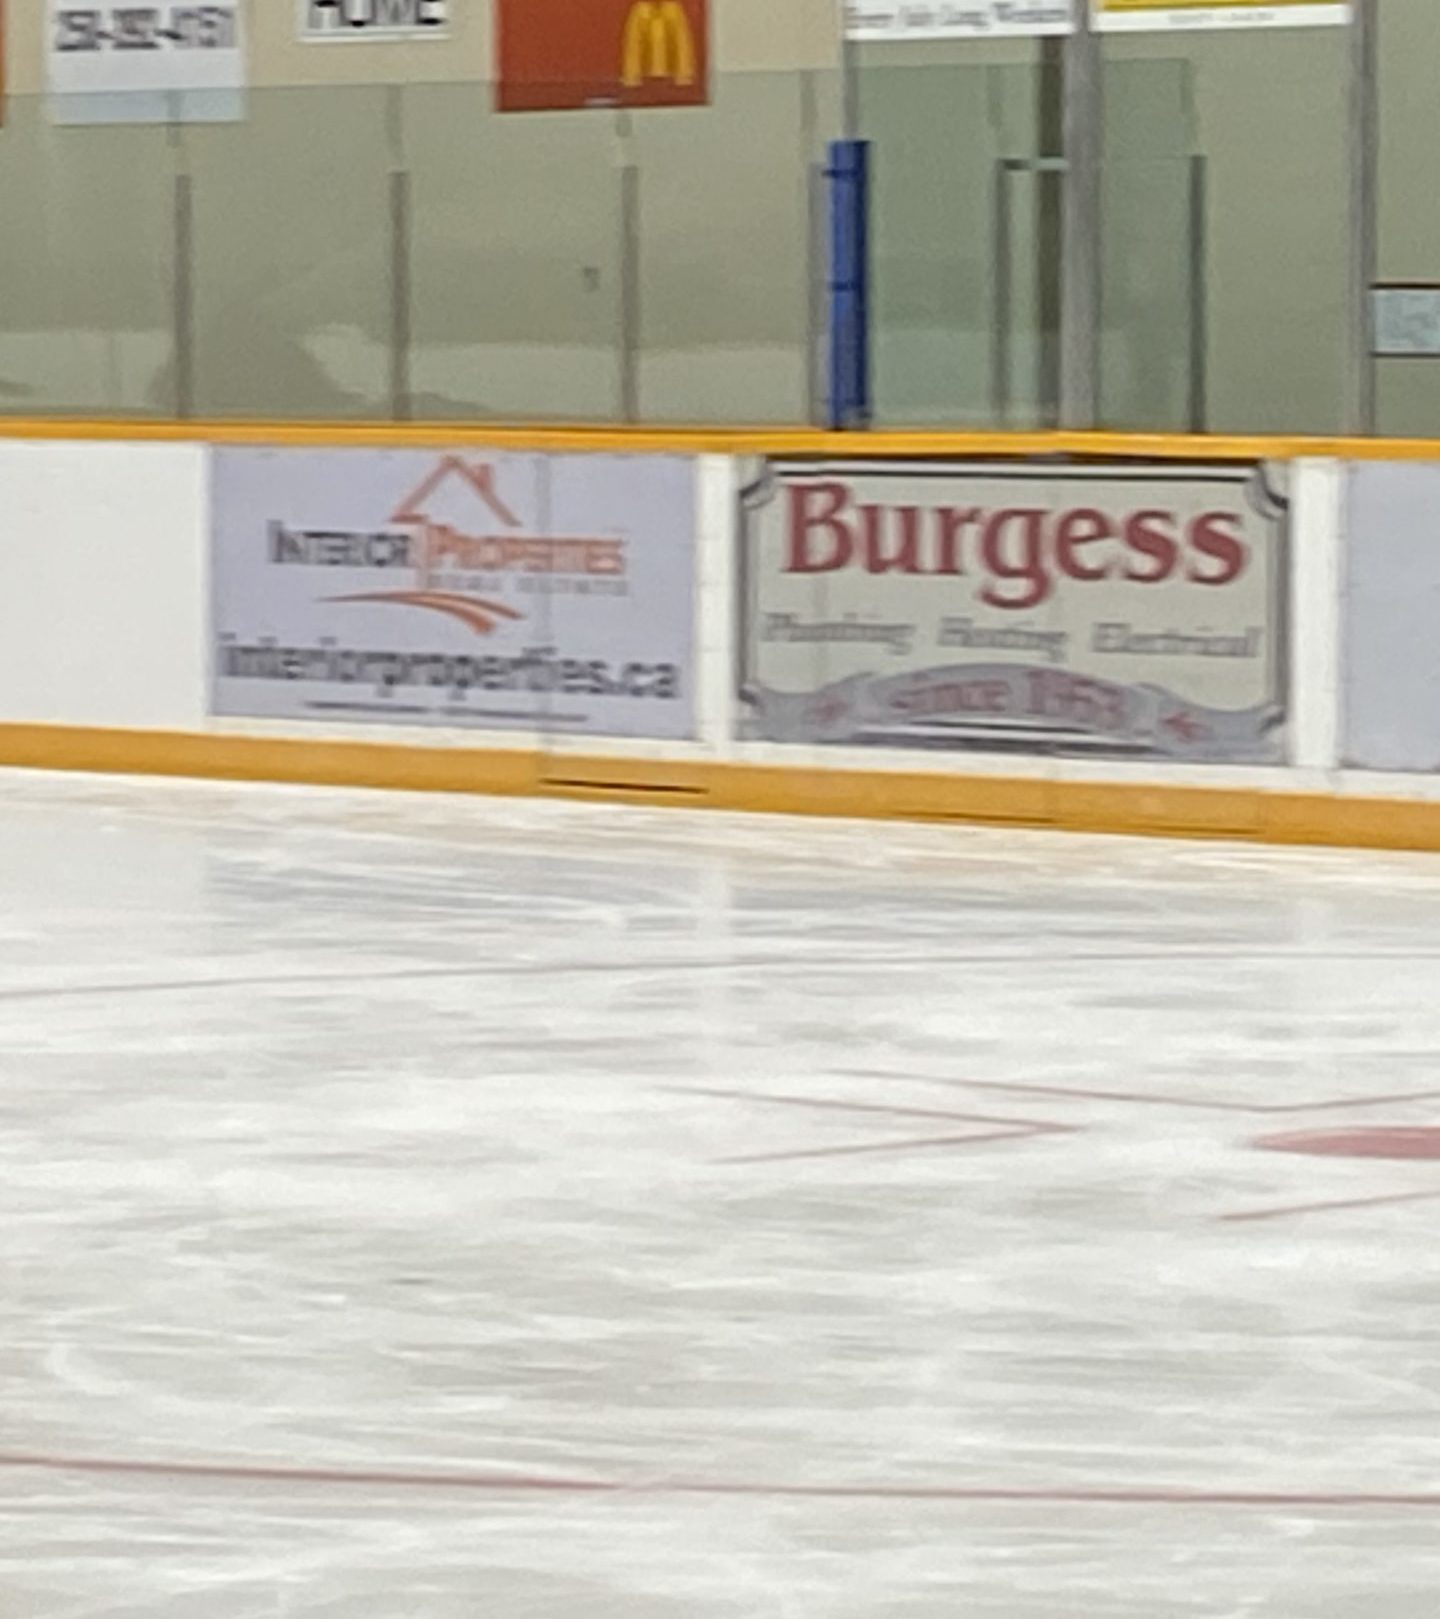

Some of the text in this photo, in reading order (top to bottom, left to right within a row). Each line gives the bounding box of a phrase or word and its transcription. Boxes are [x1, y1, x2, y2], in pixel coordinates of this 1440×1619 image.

[781, 481, 1251, 611] Burgess
[217, 632, 682, 701] interiorproperties.ca
[1092, 622, 1262, 659] Electrical
